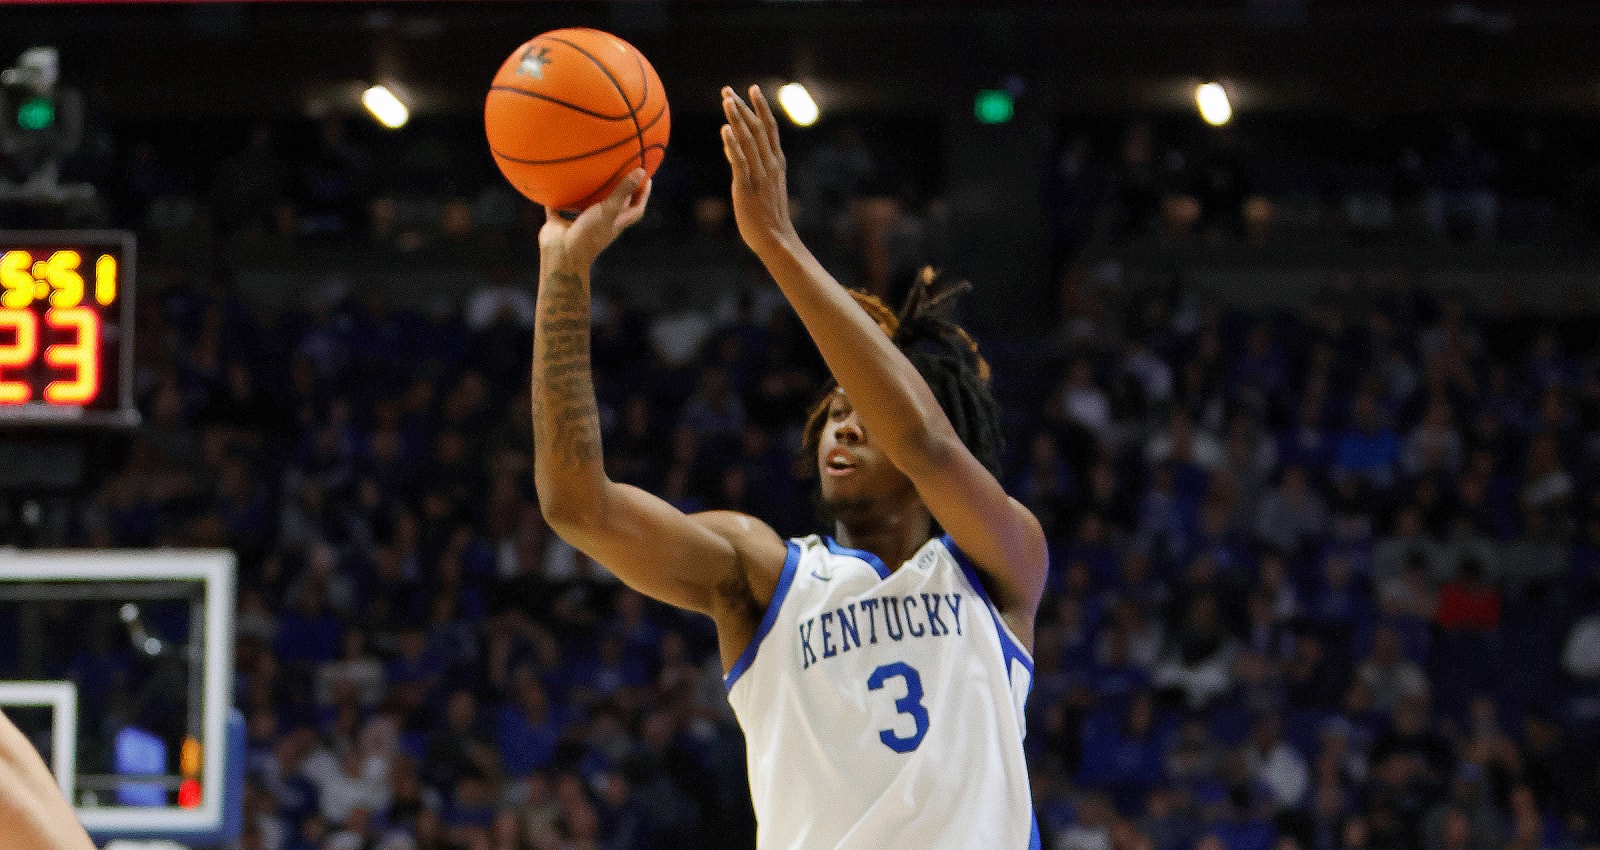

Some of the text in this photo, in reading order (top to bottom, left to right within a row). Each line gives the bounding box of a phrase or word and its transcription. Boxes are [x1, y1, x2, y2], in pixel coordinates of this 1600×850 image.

[0, 305, 99, 405] 23
[799, 593, 962, 669] KENTUCKY
[867, 661, 930, 754] 3
